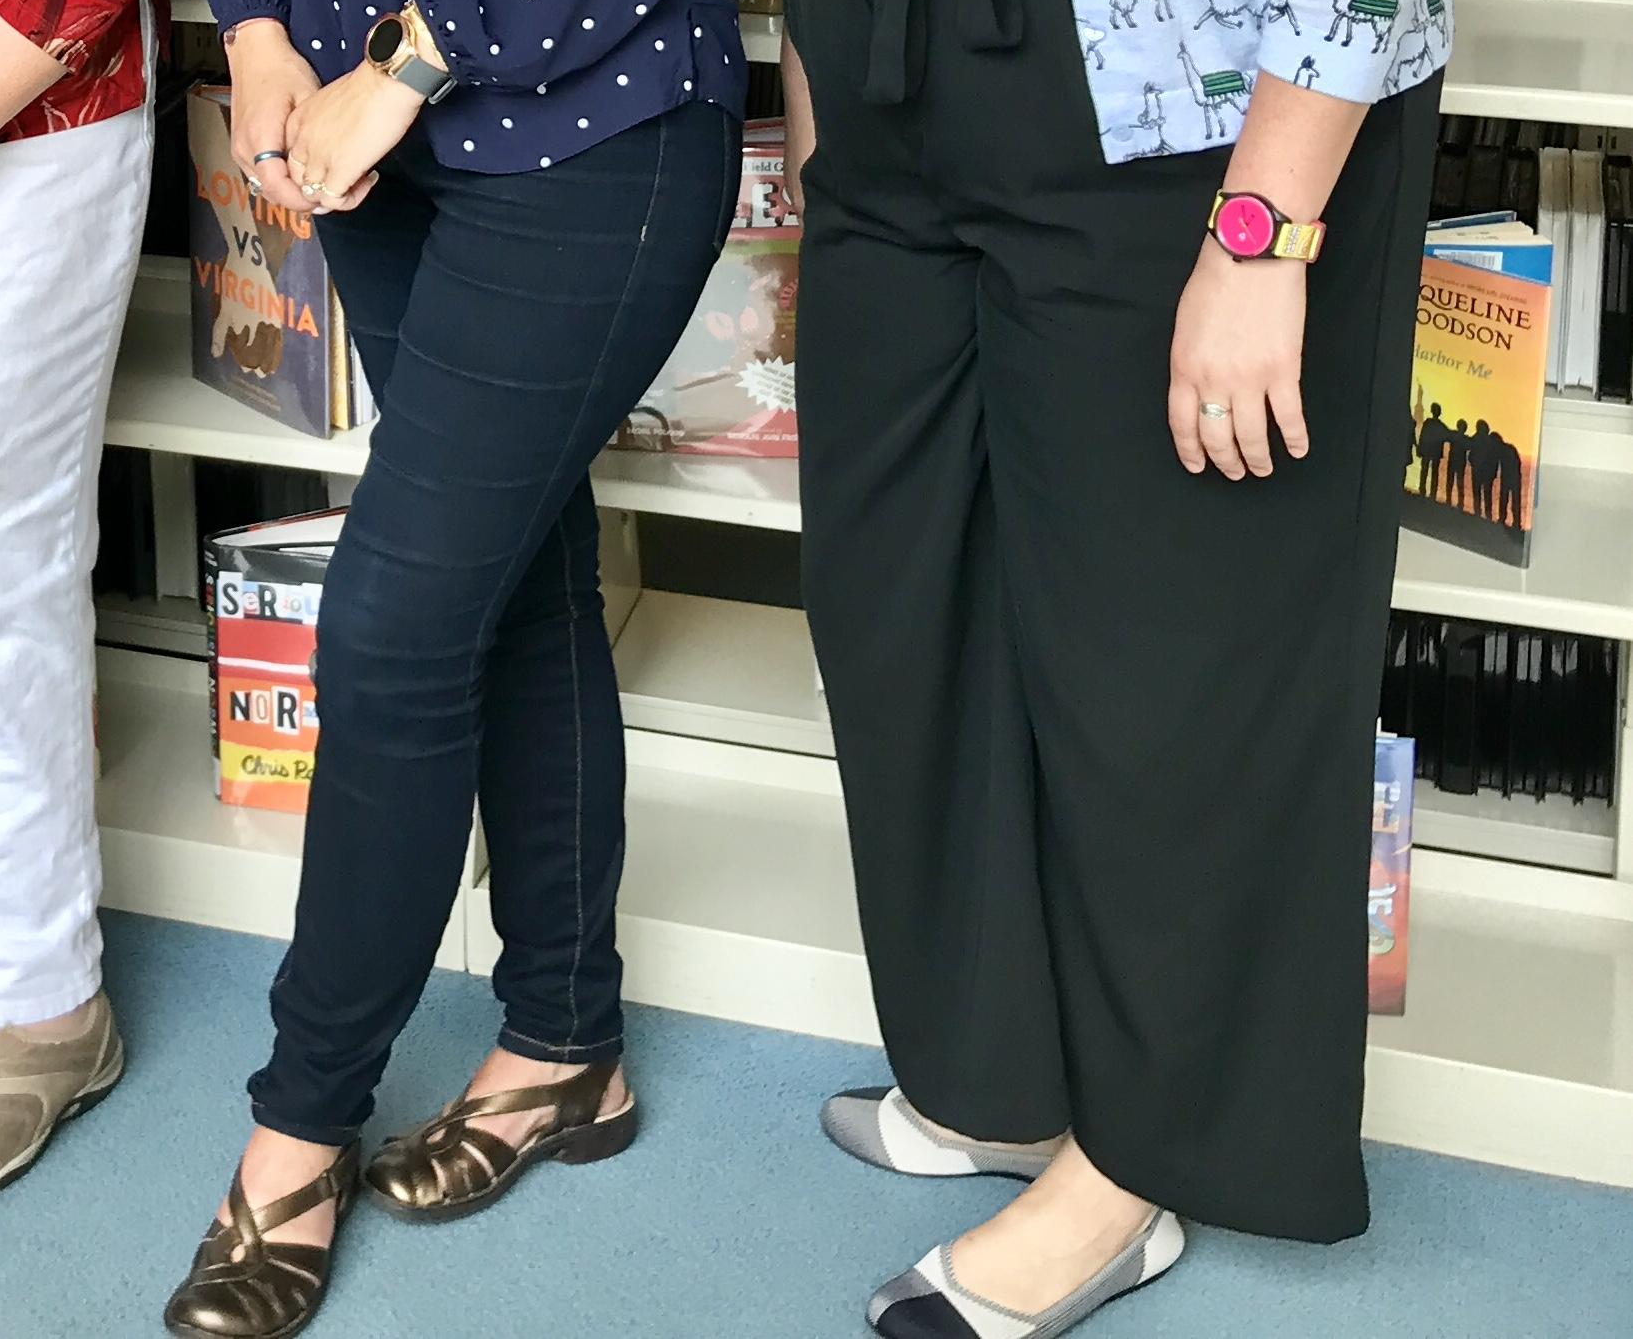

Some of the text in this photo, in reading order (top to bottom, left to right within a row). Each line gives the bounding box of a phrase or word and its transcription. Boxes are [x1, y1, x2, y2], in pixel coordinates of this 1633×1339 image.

[233, 226, 263, 266] VS
[194, 256, 319, 337] VIRGINIA
[1418, 284, 1532, 331] QUELINE
[1415, 308, 1514, 351] OODSON
[1466, 360, 1493, 380] Me
[241, 754, 289, 777] Chris
